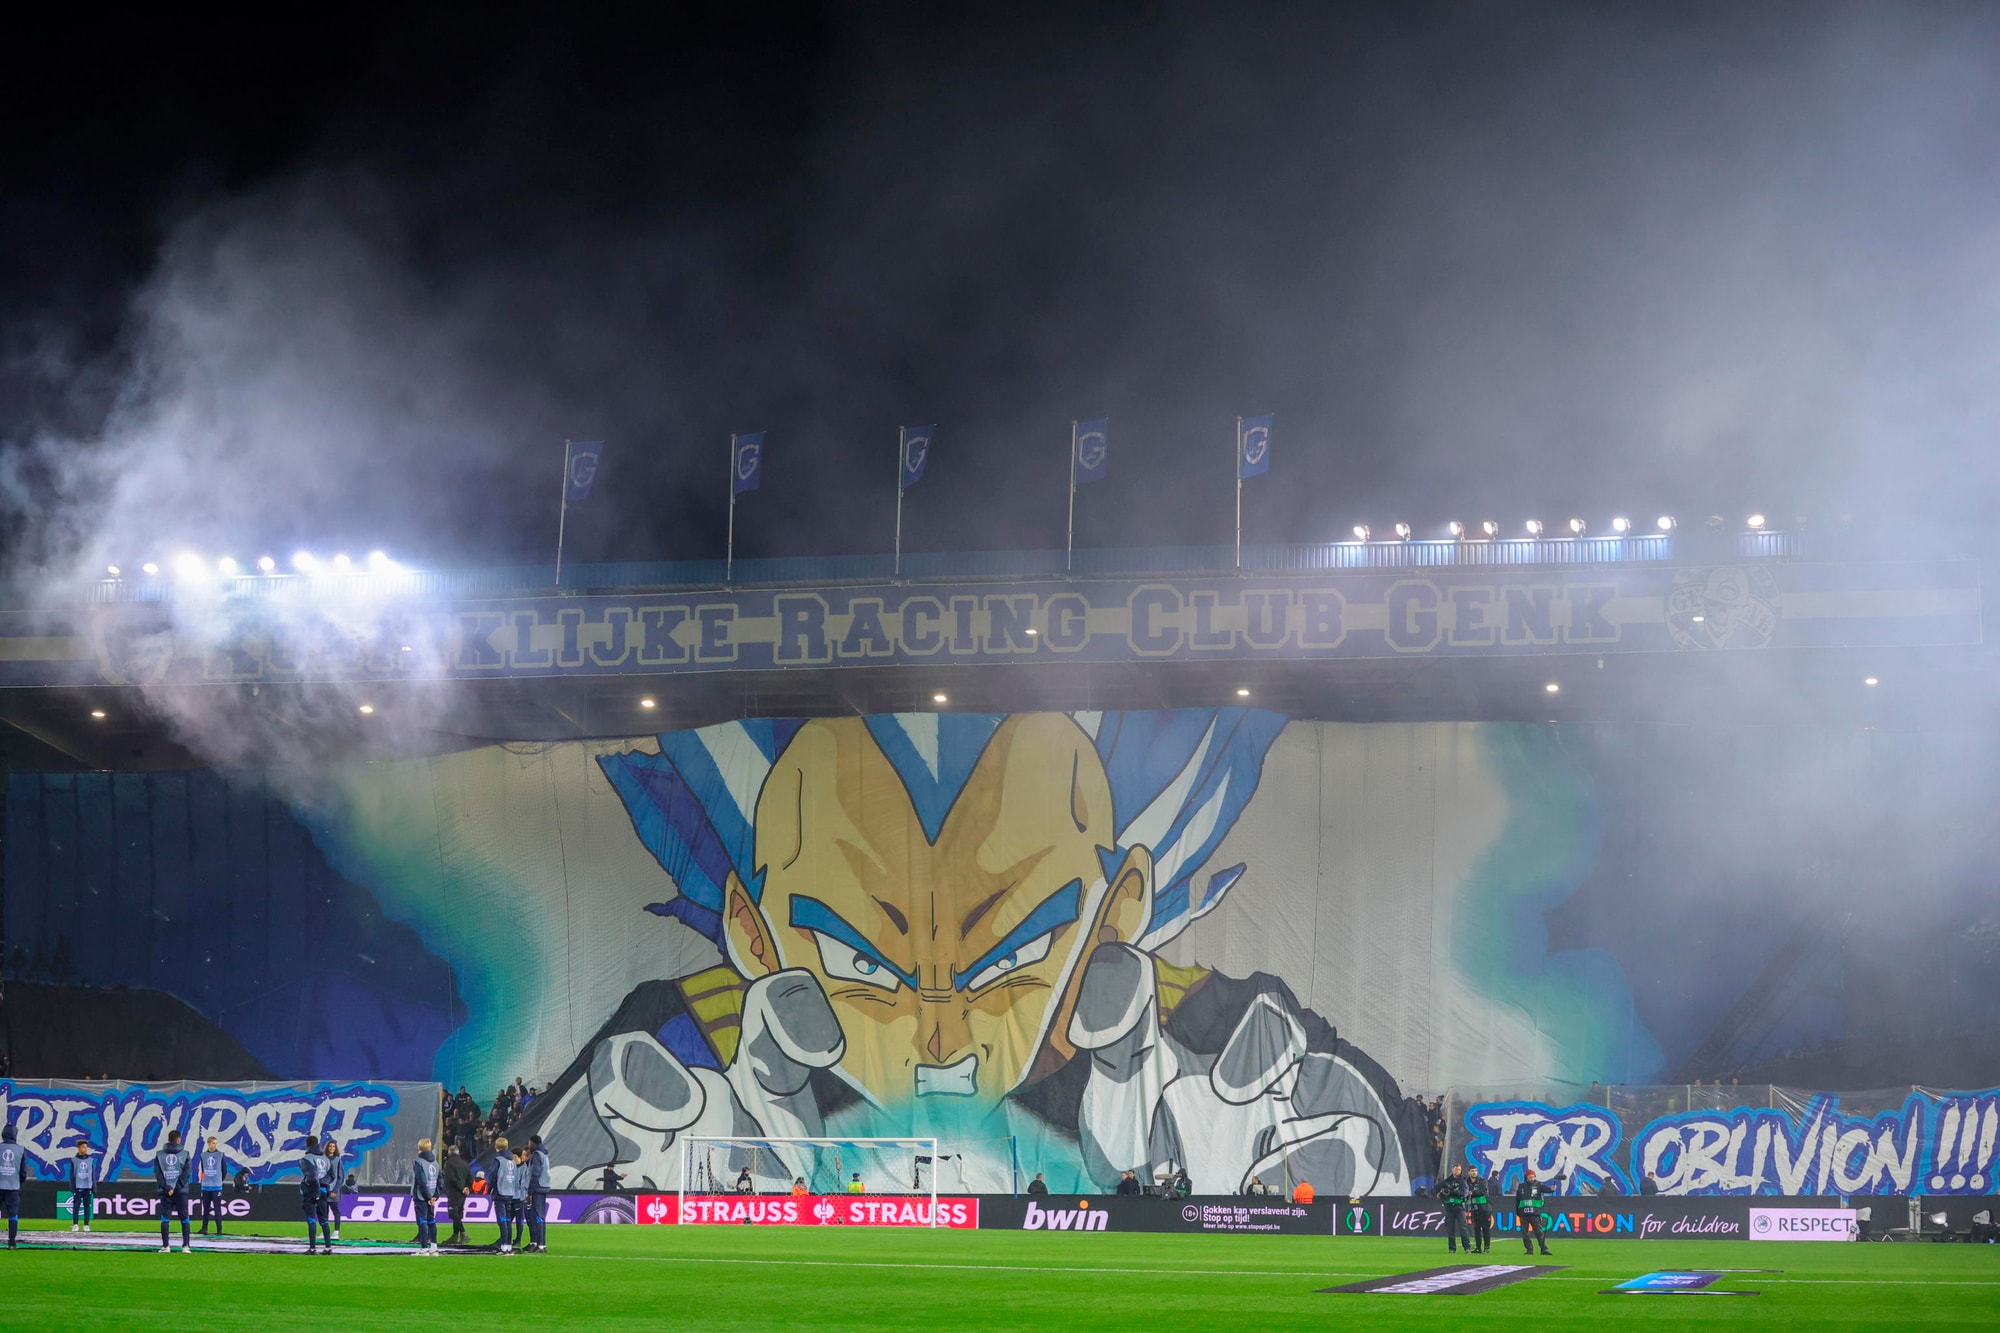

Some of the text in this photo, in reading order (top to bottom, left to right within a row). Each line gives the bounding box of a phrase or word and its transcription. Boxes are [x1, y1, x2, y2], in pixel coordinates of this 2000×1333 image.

[774, 592, 1090, 664] RACING
[1127, 583, 1347, 657] CLUB
[1384, 579, 1622, 652] GENK
[1481, 1112, 1621, 1196] FOR
[1643, 1098, 1919, 1196] OBLIVION
[683, 1201, 967, 1224] STRAUSS STRAUSS
[1023, 1200, 1109, 1231] bwin
[1203, 1205, 1308, 1218] Gokken kan verslavend zijn.
[1203, 1213, 1250, 1224] Stop op tijd!
[1639, 1213, 1666, 1240] for
[1671, 1215, 1739, 1234] children
[1778, 1217, 1853, 1232] RESPECT
